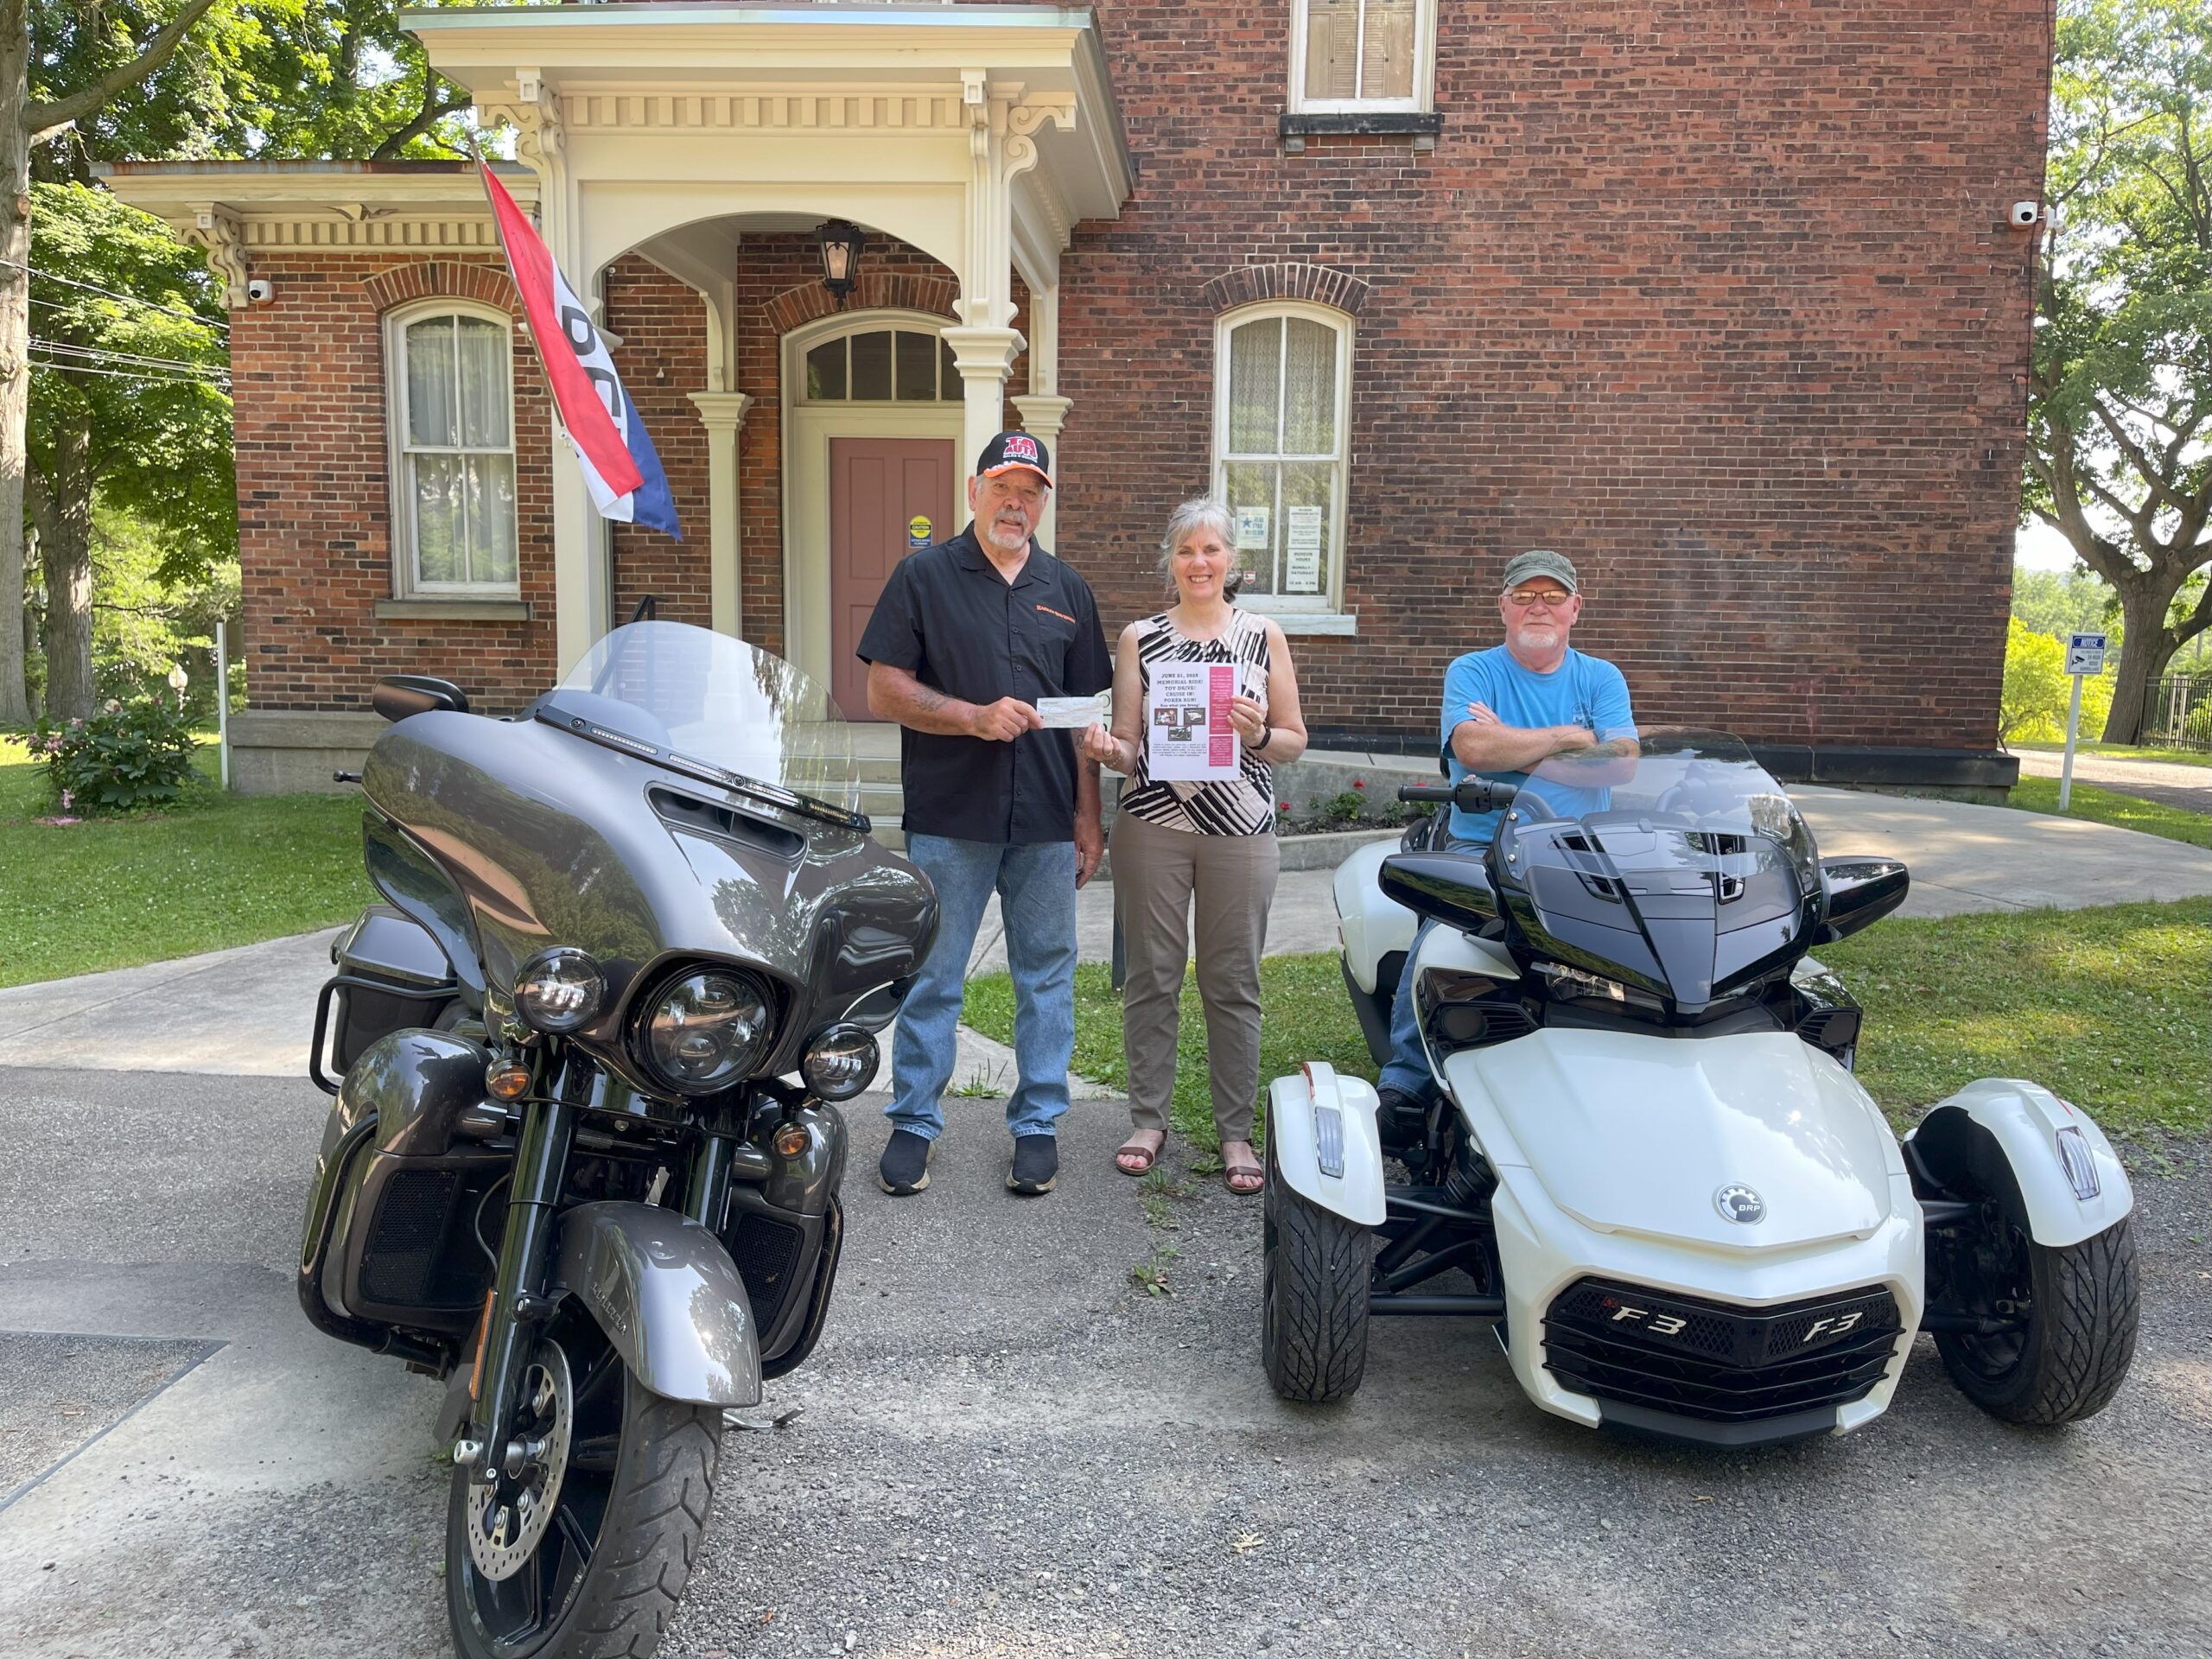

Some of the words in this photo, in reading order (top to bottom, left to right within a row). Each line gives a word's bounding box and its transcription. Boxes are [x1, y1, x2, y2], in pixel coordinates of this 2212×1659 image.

[2080, 638, 2099, 648] NOTICE
[1611, 1306, 1687, 1335] F3
[1802, 1312, 1863, 1342] F3
